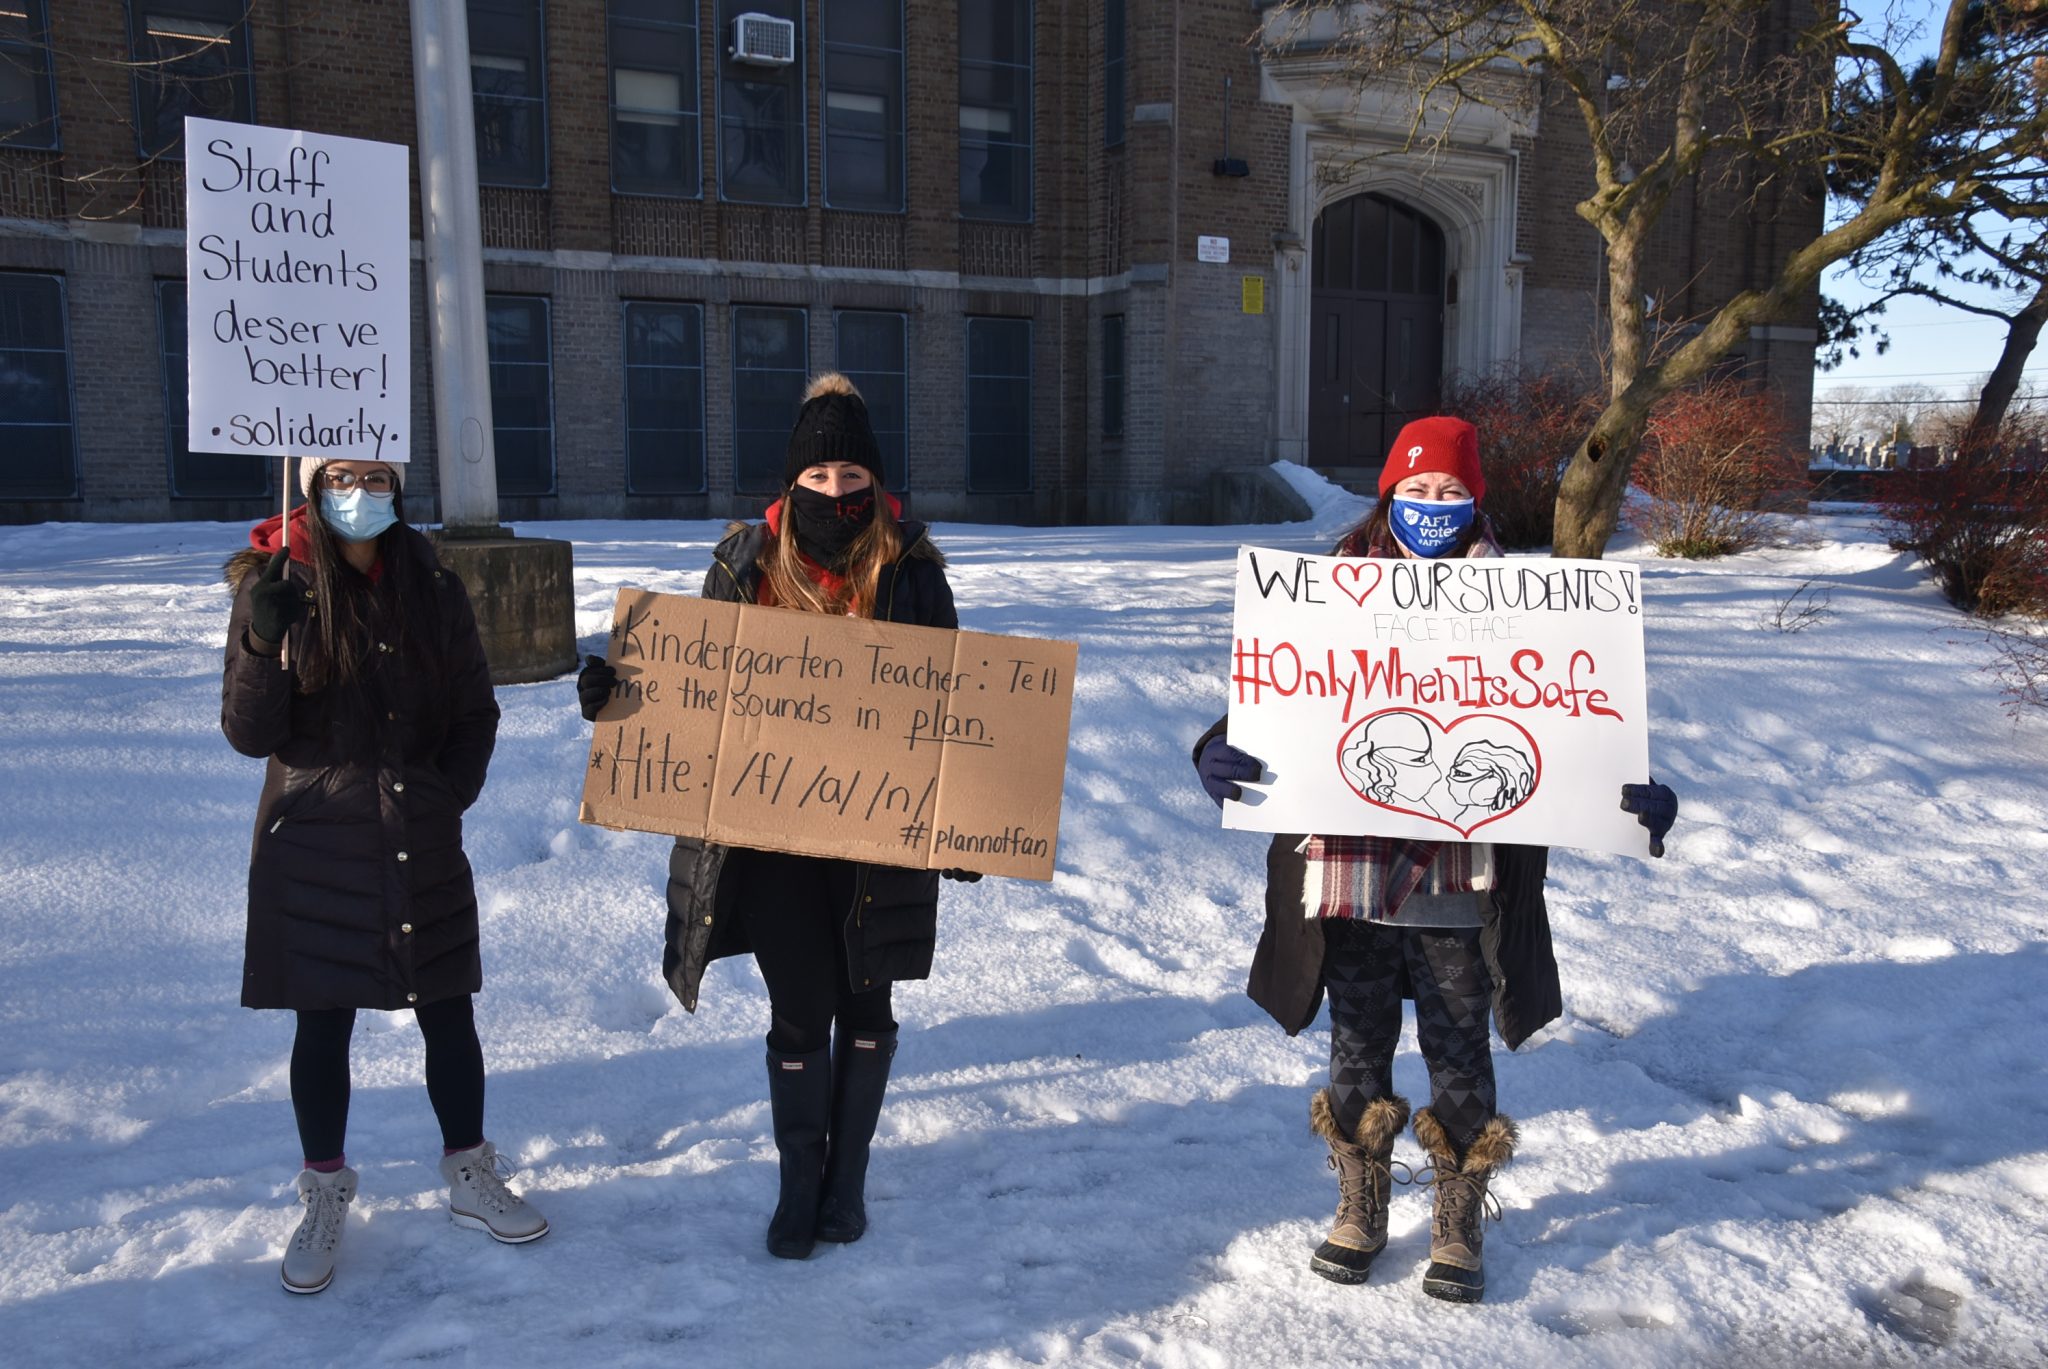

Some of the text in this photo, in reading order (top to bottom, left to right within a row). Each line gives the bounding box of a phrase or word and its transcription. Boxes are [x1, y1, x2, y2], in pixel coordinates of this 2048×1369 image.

[202, 139, 330, 198] Staff
[251, 199, 335, 238] and
[199, 235, 378, 291] Students
[213, 299, 380, 348] deserve
[244, 345, 388, 399] better!
[1407, 446, 1423, 469] P
[1420, 514, 1452, 527] AFT
[1249, 552, 1638, 614] WE OUR STUDENTS!
[1373, 613, 1441, 642] FACE
[1469, 615, 1523, 643] FACE
[1008, 659, 1058, 696] Tell
[1232, 637, 1624, 723] #OnlyWhenItsSafe
[615, 677, 994, 750] me the sounds in plan.
